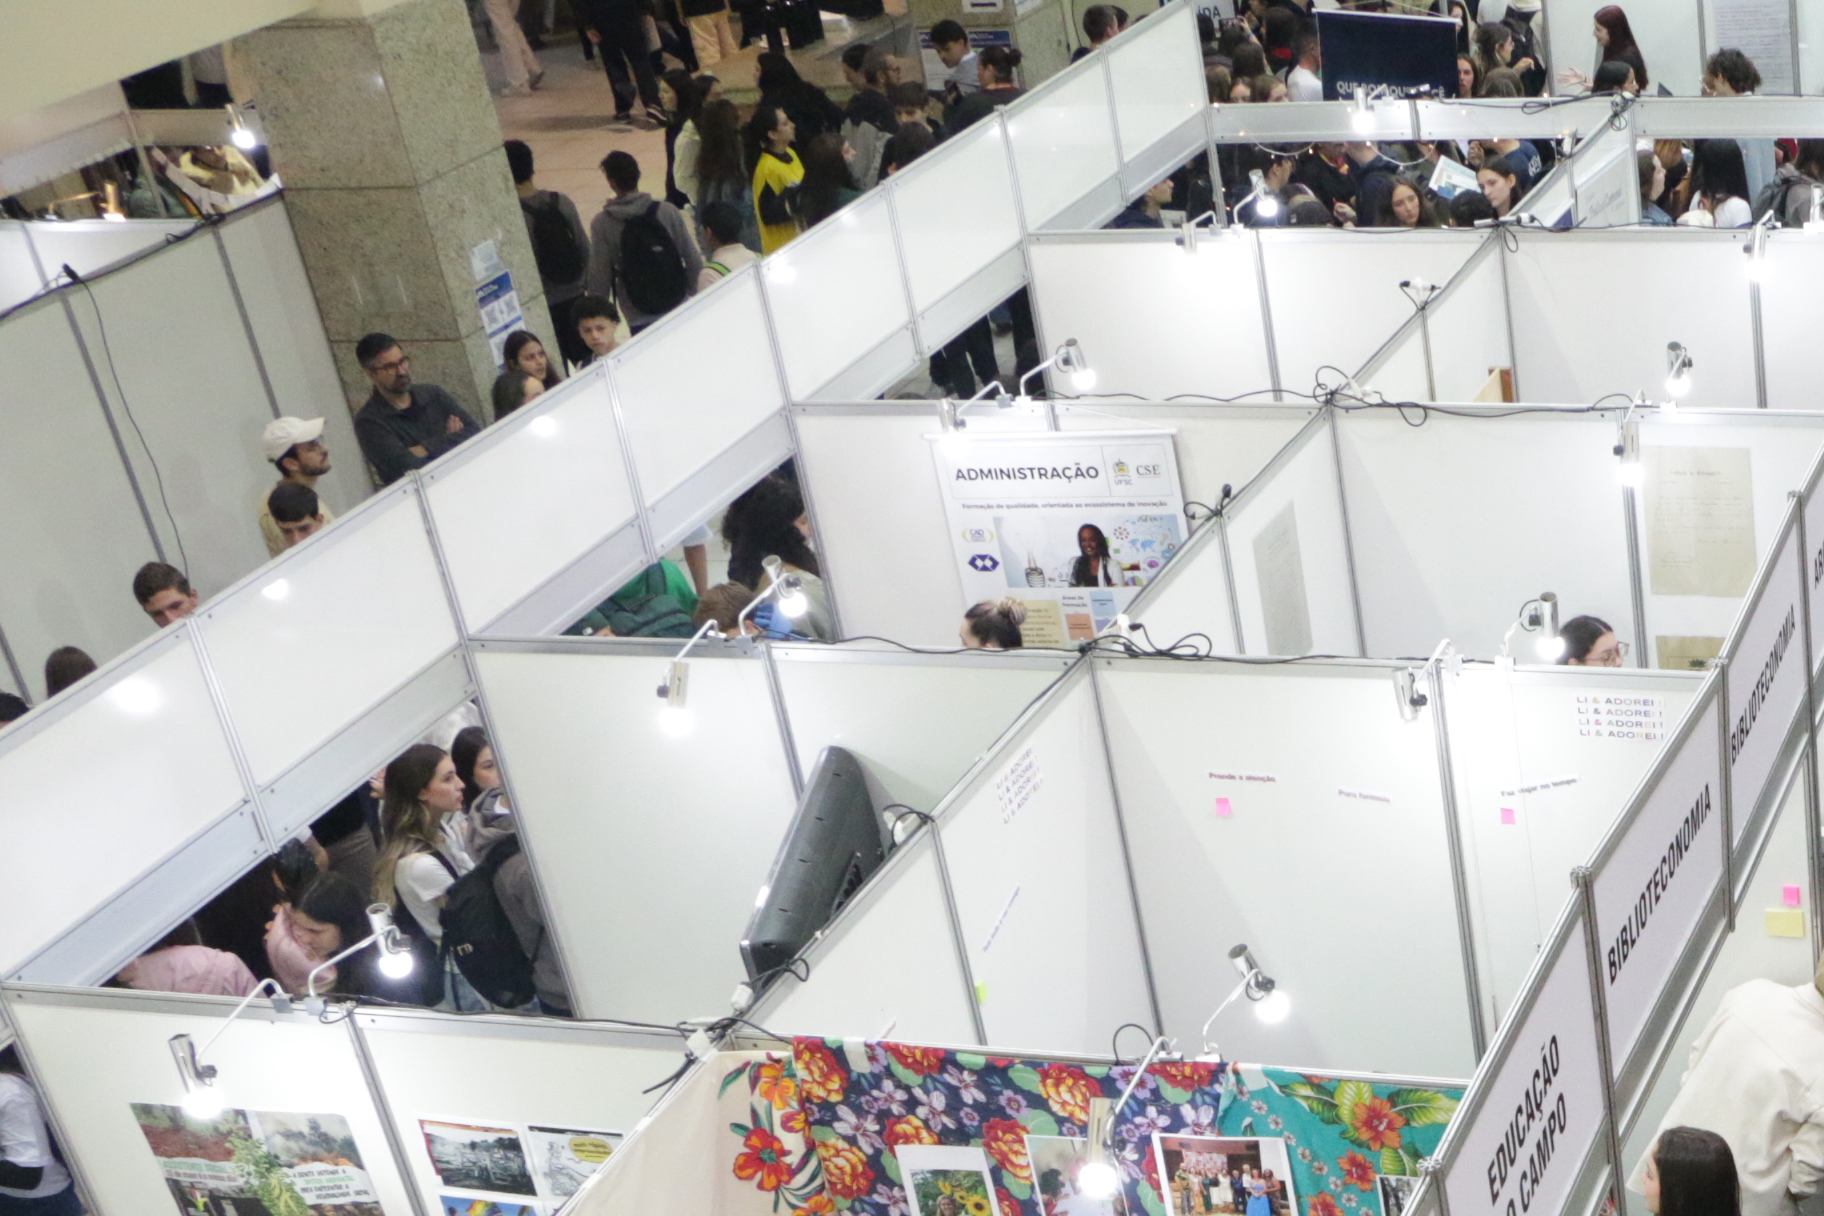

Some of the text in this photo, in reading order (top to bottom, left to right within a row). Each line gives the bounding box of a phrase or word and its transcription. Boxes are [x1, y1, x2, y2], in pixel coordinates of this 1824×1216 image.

[955, 463, 1100, 483] ADMINISTRAÇÃO
[1136, 464, 1161, 476] CSE
[1114, 478, 1133, 486] UFSC
[962, 502, 995, 511] Formação
[996, 502, 1004, 510] de
[1041, 502, 1074, 510] orientada
[1084, 501, 1126, 509] ecossistema
[1127, 501, 1136, 509] de
[1137, 500, 1168, 510] inovação
[1731, 603, 1796, 766] BIBLIOTECONOMIA
[1577, 696, 1588, 704] LI
[1605, 697, 1654, 707] ADOREI
[1593, 707, 1601, 715] &
[1606, 708, 1655, 718] ADOREI
[1579, 718, 1590, 726] LI
[1594, 718, 1602, 726] &
[1607, 719, 1656, 729] ADOREI
[1580, 729, 1591, 737] LI
[1595, 729, 1603, 737] &
[1608, 730, 1657, 740] ADOREI
[1208, 771, 1236, 781] Prende
[1245, 773, 1276, 784] atenção
[1551, 776, 1578, 791] tempo
[1607, 781, 1711, 986] BIBLIOTECONOMIA
[1487, 1034, 1560, 1207] EDUCAÇÃO
[1520, 1093, 1566, 1200] CAMPO
